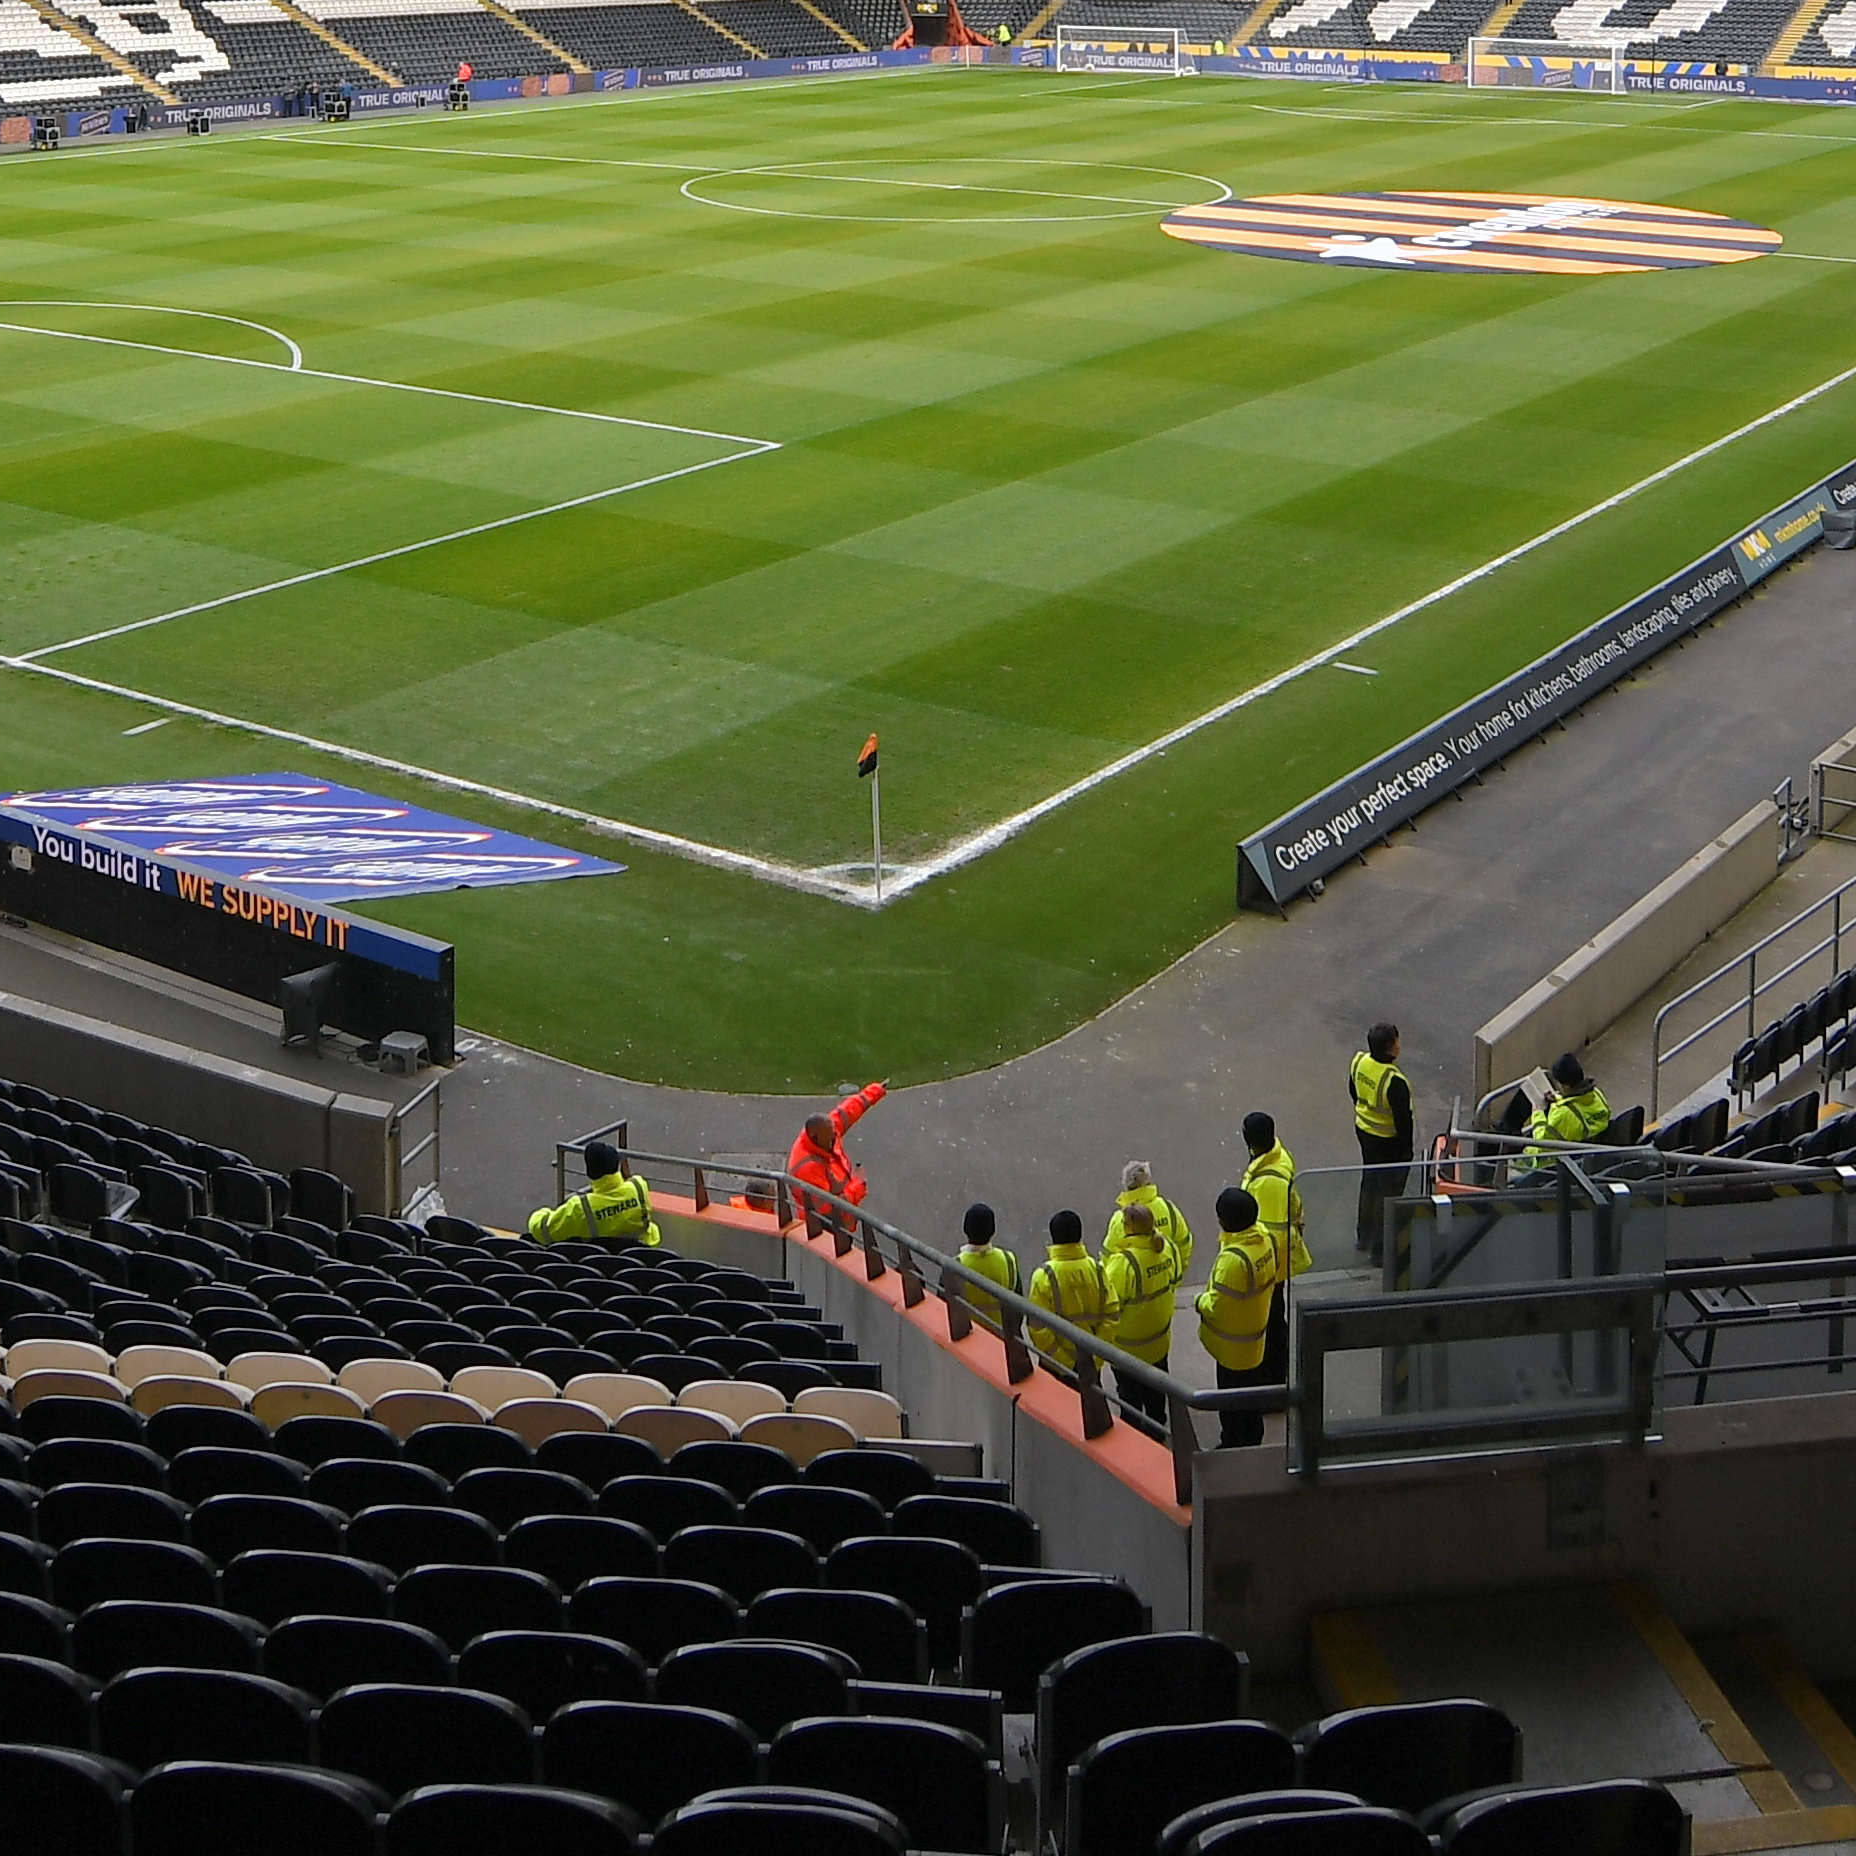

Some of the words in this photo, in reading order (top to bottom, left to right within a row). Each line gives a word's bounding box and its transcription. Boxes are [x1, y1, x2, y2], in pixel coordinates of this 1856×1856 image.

[806, 59, 831, 71] TRUE
[832, 56, 879, 69] ORIGINALS
[1086, 54, 1117, 67] TRUE
[1261, 61, 1292, 74] TRUE
[1295, 63, 1359, 76] ORIGINALS
[663, 70, 691, 82] TRUE
[693, 66, 743, 81] ORIGINALS
[1628, 76, 1665, 89] TRUE
[1669, 77, 1746, 92] ORIGINALS
[359, 93, 390, 107] TRUE
[1275, 823, 1331, 871] Create
[1325, 804, 1363, 847] your
[1361, 771, 1412, 824] perfect
[1407, 751, 1453, 789] space.
[1444, 720, 1482, 760] Your
[1479, 706, 1516, 743] home
[1508, 697, 1530, 721] for
[1523, 670, 1577, 711] kitchens,
[1566, 638, 1628, 684] bathrooms,
[1616, 604, 1680, 650] landscaping,
[1690, 580, 1710, 604] and
[1703, 565, 1739, 599] joinery.
[31, 824, 76, 864] You
[80, 833, 139, 884] build
[143, 857, 161, 892] it
[176, 868, 216, 909] WE
[222, 883, 320, 941] SUPPLY
[324, 915, 350, 952] IT
[596, 1197, 638, 1221] STEWARD
